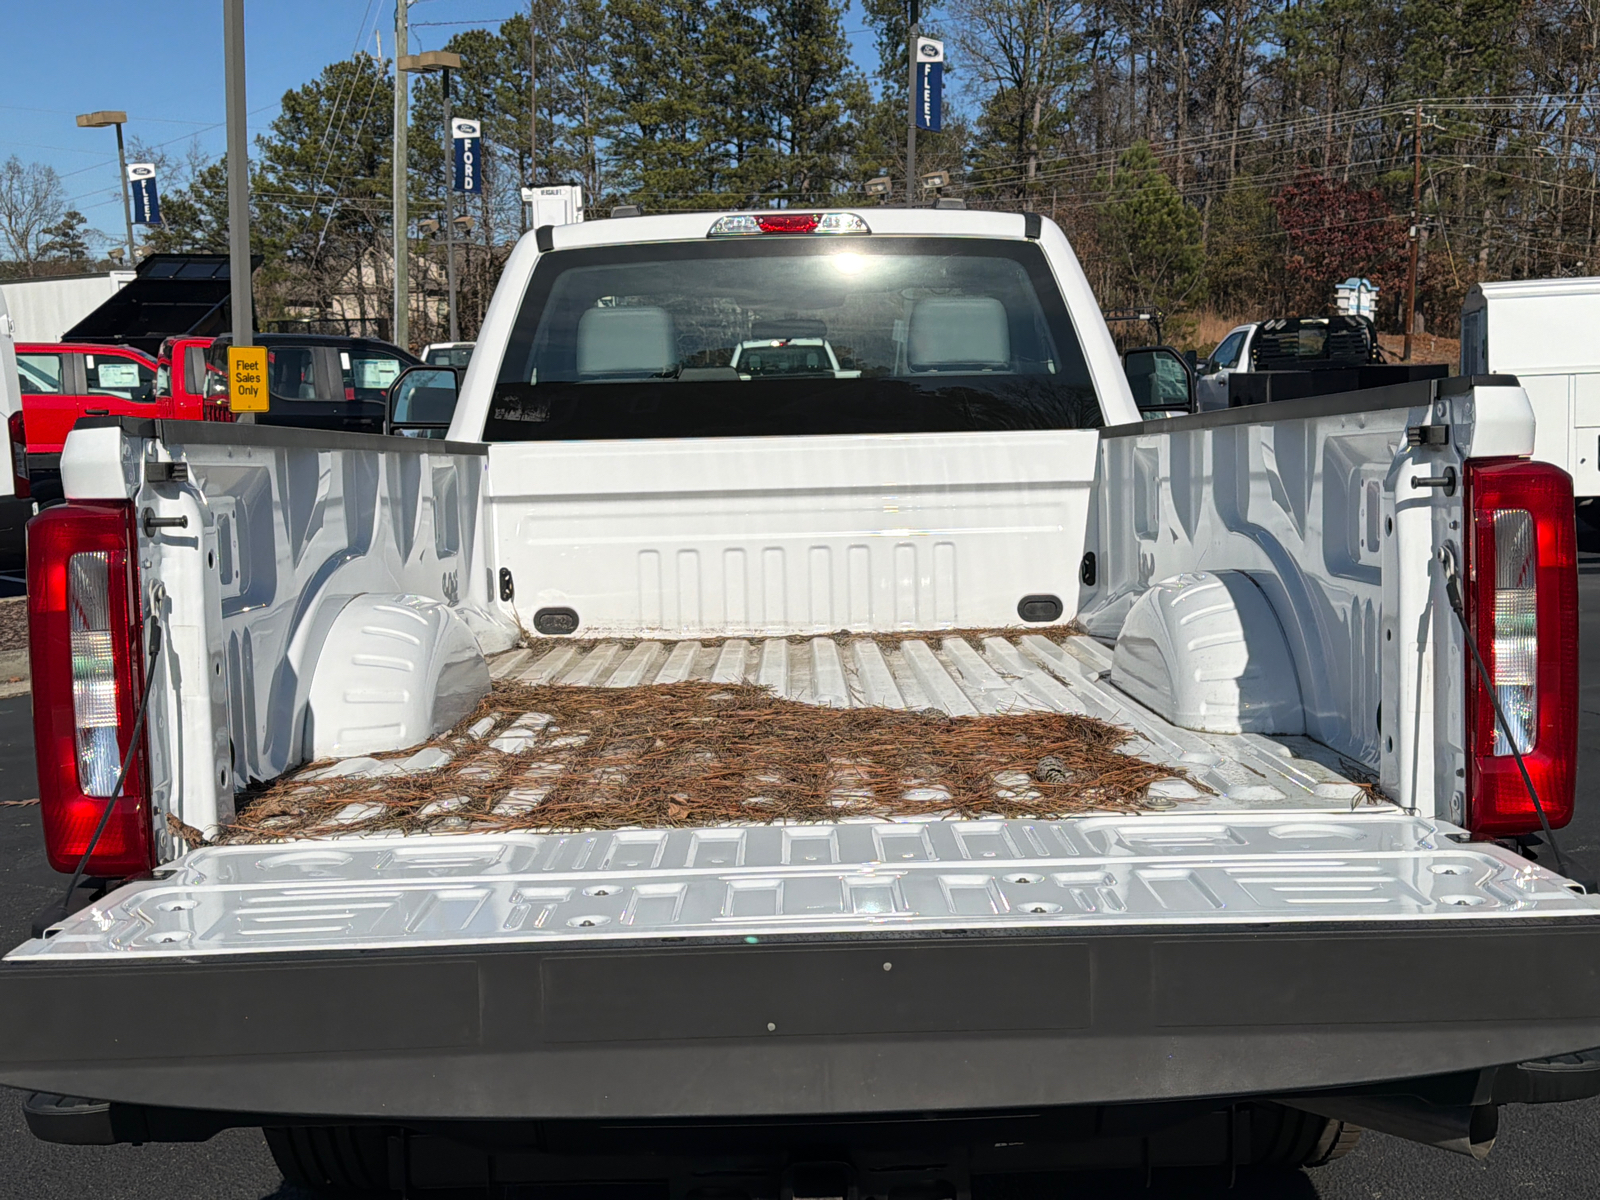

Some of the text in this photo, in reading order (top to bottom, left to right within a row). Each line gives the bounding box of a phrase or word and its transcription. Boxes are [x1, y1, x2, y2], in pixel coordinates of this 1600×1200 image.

[923, 64, 931, 126] FLEET
[463, 138, 474, 190] FORD
[140, 180, 151, 222] FLEET
[235, 372, 261, 383] Sales
[236, 360, 259, 371] Fleet
[238, 384, 259, 398] Only
